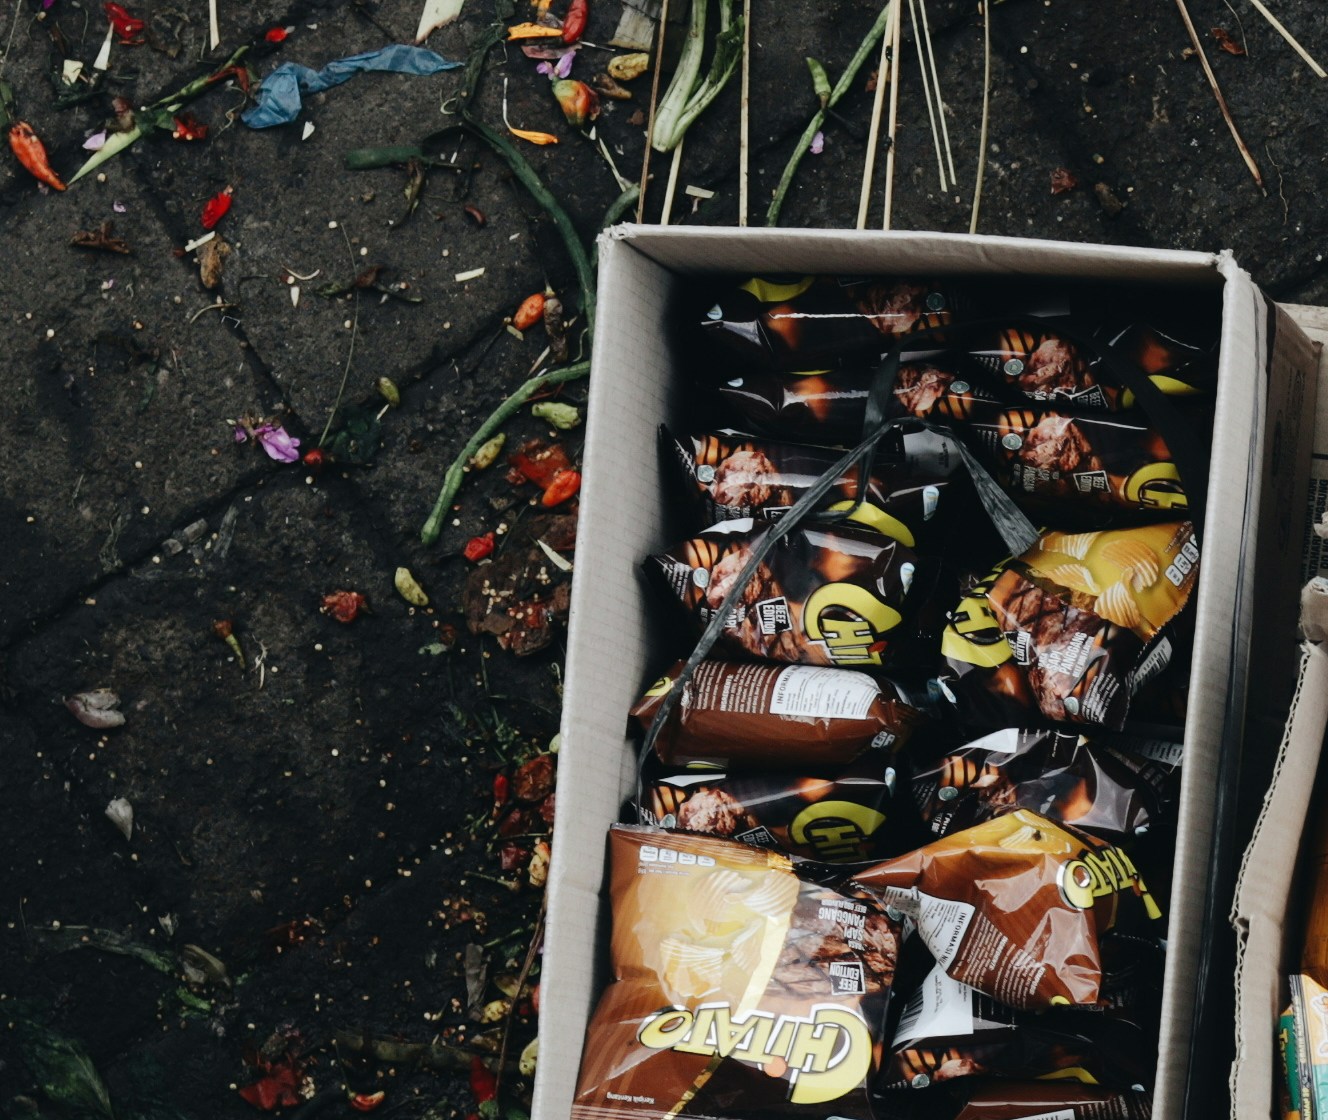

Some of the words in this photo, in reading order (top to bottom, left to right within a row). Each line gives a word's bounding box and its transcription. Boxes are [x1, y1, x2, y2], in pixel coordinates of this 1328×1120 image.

[762, 603, 776, 635] EDITION
[774, 603, 788, 626] BEEF
[804, 582, 902, 665] CHIT
[1016, 630, 1031, 665] EDITION
[1048, 647, 1065, 673] SAPI
[1059, 631, 1088, 676] PANGGANG
[818, 907, 866, 928] PANGGANG
[843, 927, 865, 941] SAPI
[946, 911, 969, 958] INFORMASI
[829, 964, 860, 981] EDITION
[837, 978, 860, 994] BEEF
[636, 1001, 873, 1105] CHITATO
